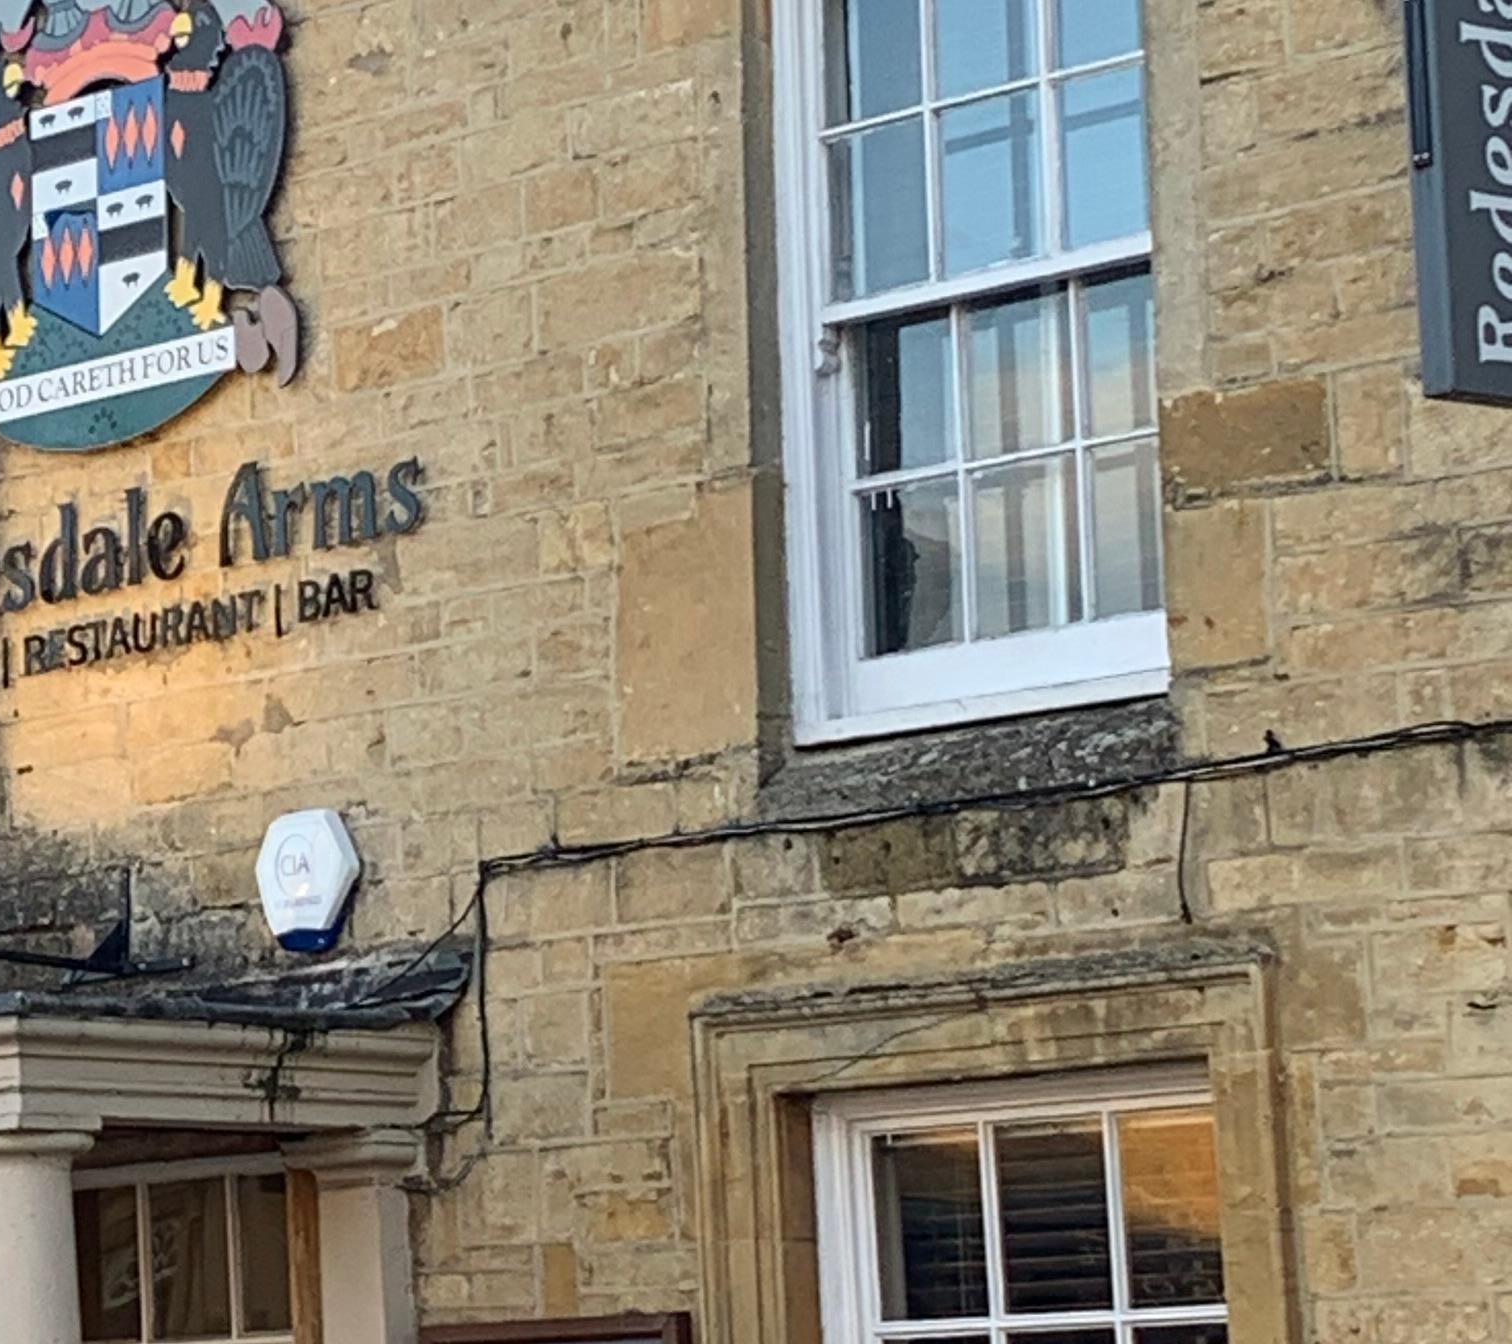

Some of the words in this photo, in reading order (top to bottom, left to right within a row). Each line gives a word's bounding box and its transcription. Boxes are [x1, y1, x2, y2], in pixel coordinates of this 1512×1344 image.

[37, 357, 136, 403] CARETH
[141, 346, 192, 379] FOR
[197, 335, 229, 365] US
[220, 456, 425, 567] Arms
[23, 590, 265, 676] RESTAURANT
[298, 568, 378, 624] BAR
